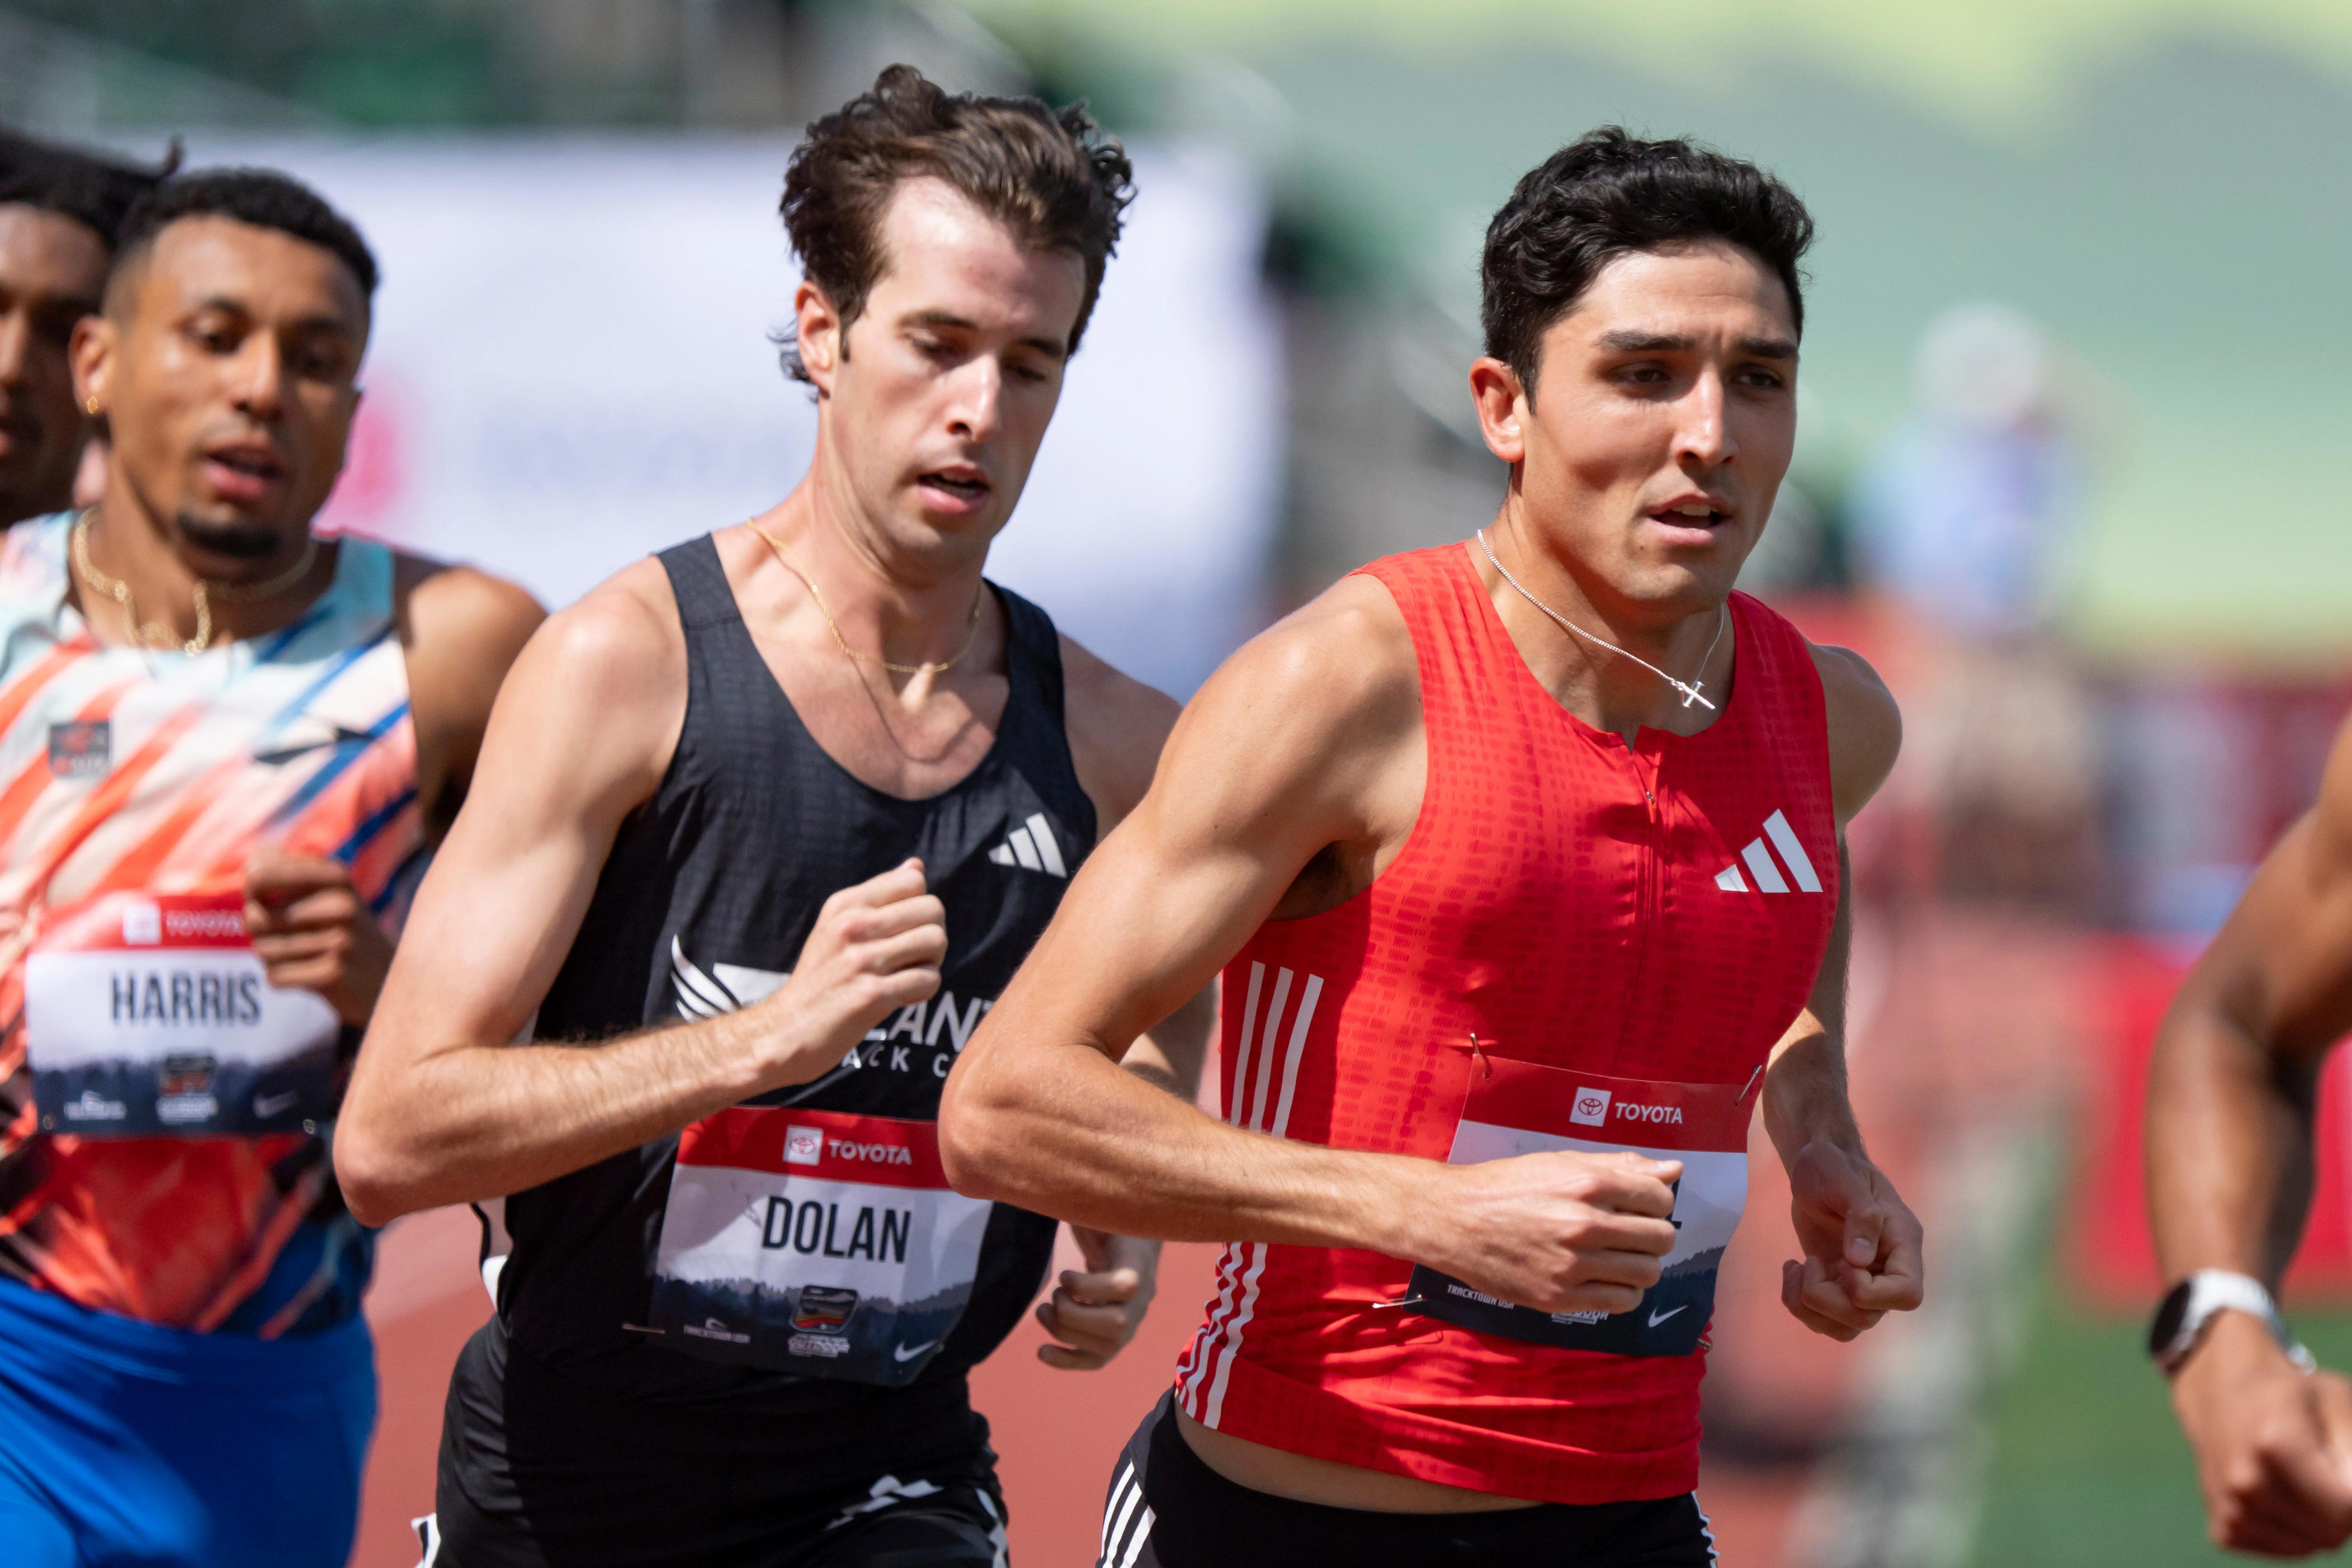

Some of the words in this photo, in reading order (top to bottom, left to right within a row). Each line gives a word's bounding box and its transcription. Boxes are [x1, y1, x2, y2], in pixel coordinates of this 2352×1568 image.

[166, 911, 243, 937] TOYOTA
[111, 971, 261, 1023] HARRIS
[1614, 1102, 1683, 1125] TOYOTA
[828, 1140, 912, 1165] TOYOTA
[761, 1196, 912, 1264] DOLAN
[1447, 1284, 1497, 1305] TRACKTOWN
